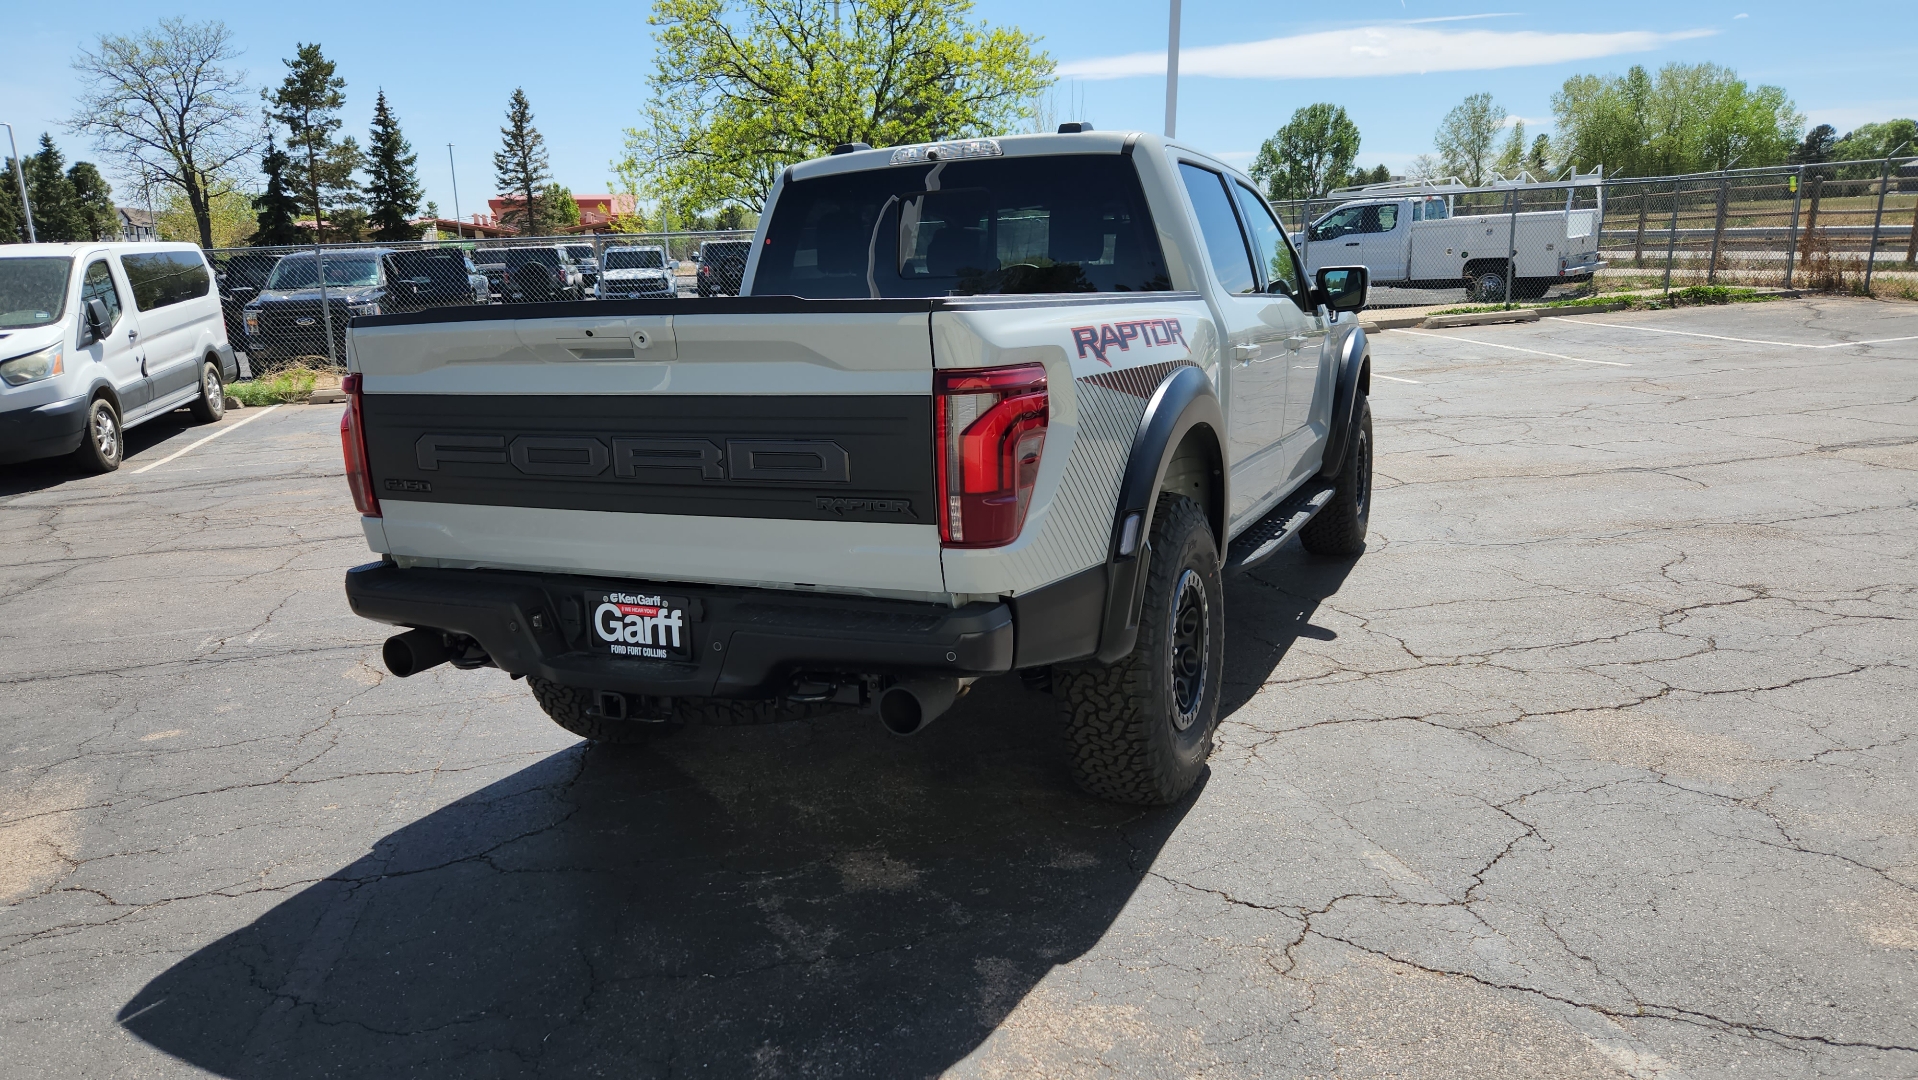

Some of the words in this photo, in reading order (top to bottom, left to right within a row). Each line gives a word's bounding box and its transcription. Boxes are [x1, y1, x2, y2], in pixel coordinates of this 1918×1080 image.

[1070, 318, 1192, 368] RAPTOR
[414, 431, 852, 483] FORD
[384, 478, 432, 493] F-150
[815, 495, 920, 519] RAPTOR
[618, 593, 637, 604] Ken
[637, 594, 661, 606] Garff
[594, 603, 682, 647] Garff
[611, 645, 626, 654] FORD
[627, 645, 642, 655] FORT
[643, 647, 667, 658] COLLINS
